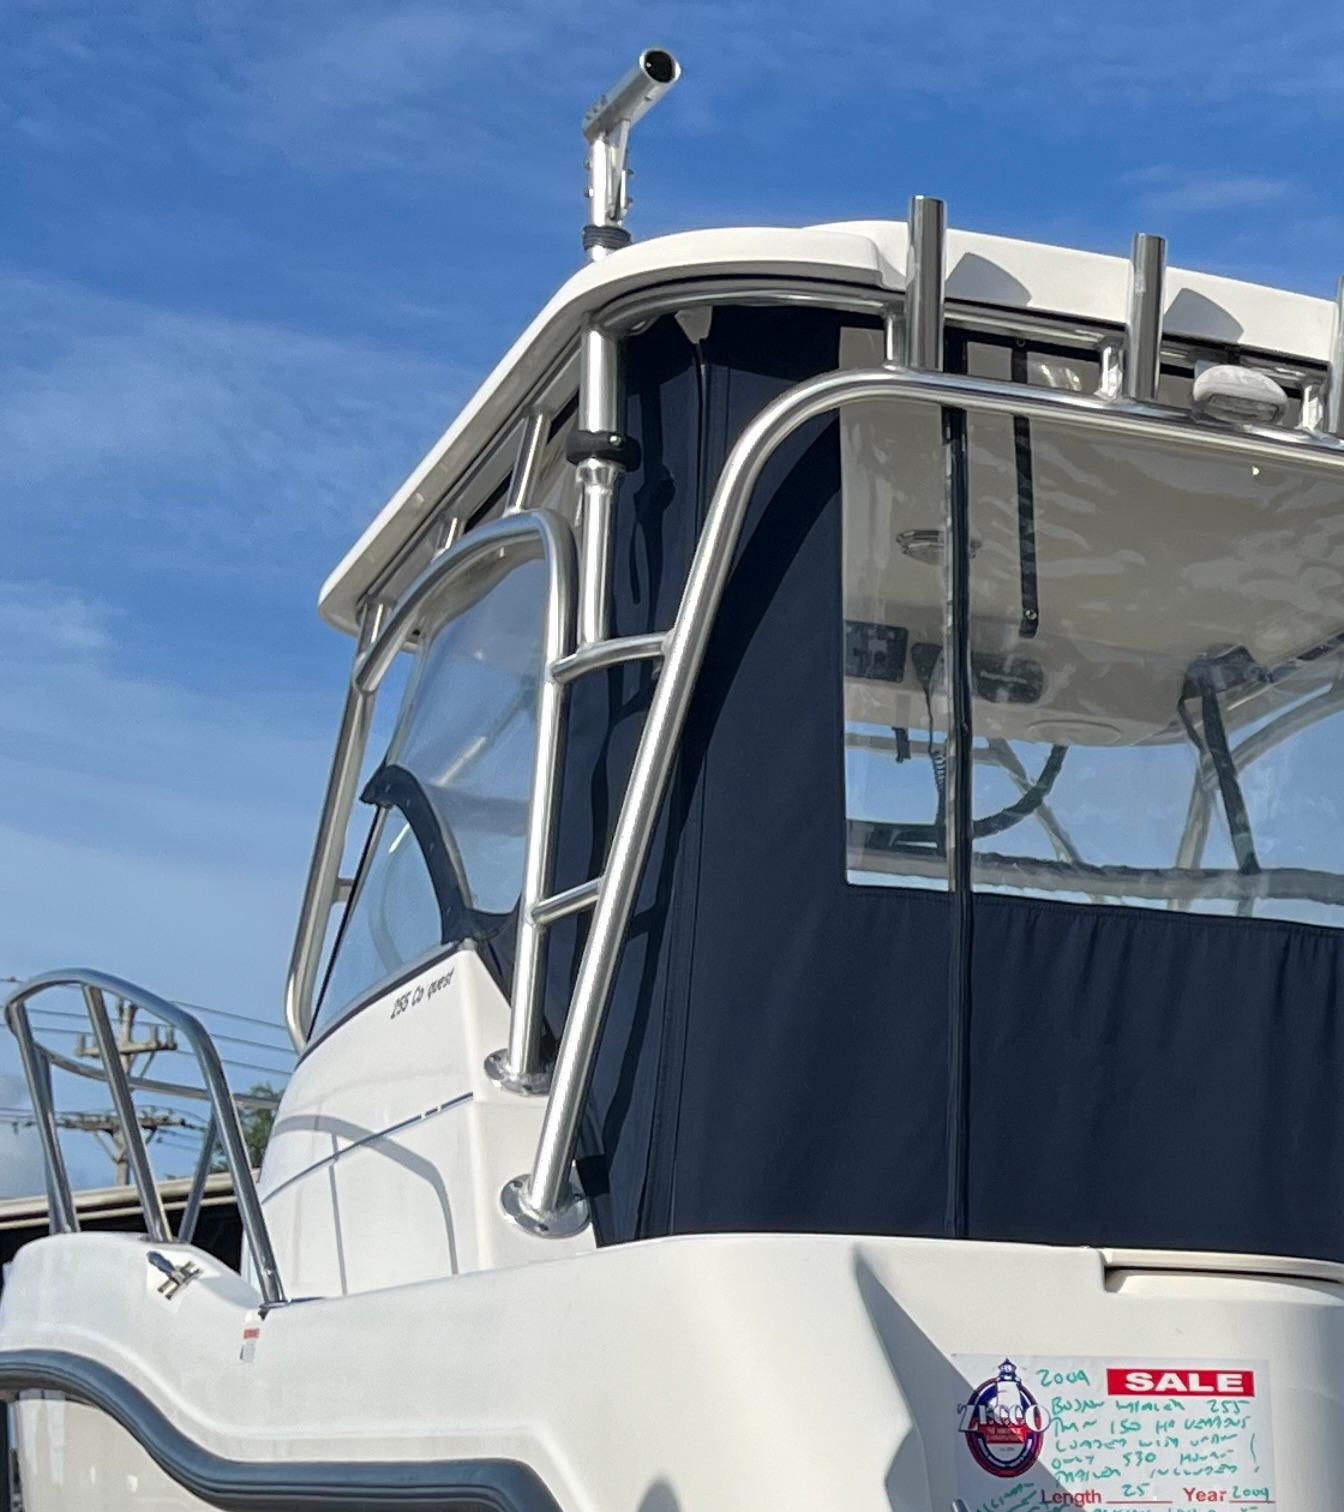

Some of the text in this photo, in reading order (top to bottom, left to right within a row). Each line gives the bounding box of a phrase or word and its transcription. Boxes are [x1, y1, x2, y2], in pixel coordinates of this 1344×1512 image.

[1036, 1368, 1090, 1388] 2009
[1124, 1371, 1245, 1393] SALE
[1206, 1399, 1251, 1415] 255
[1109, 1420, 1142, 1435] 150
[1122, 1451, 1158, 1466] 530
[1041, 1489, 1102, 1507] Length
[1183, 1487, 1227, 1502] Year
